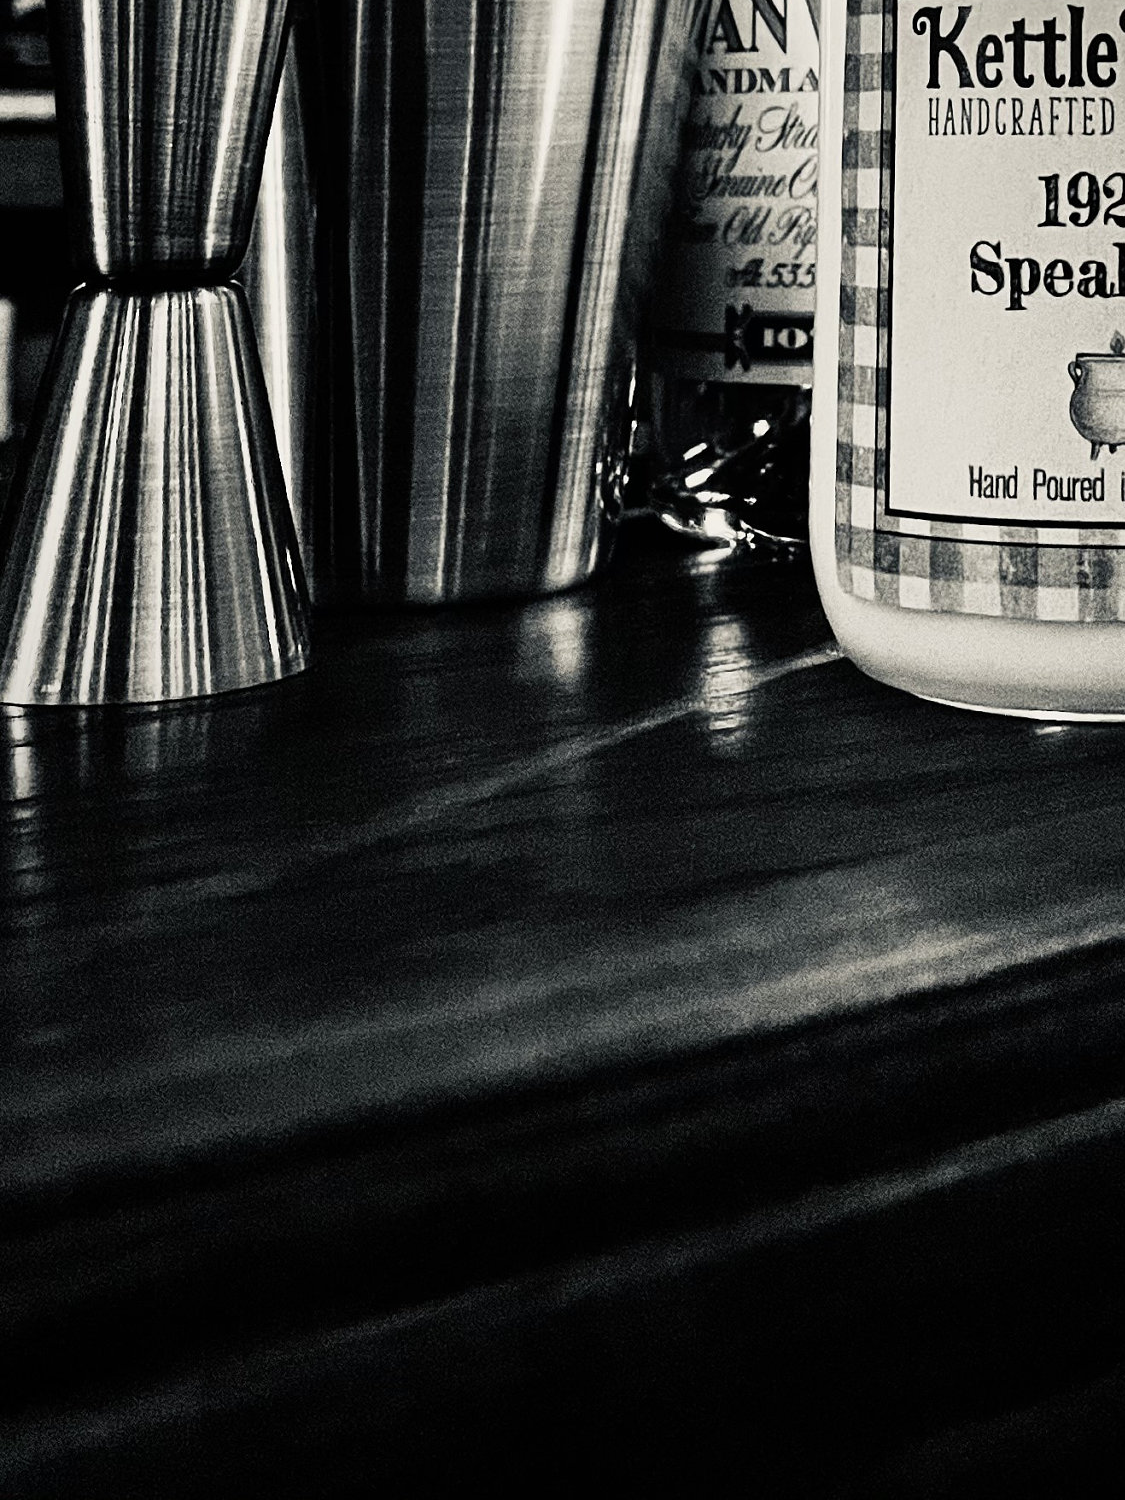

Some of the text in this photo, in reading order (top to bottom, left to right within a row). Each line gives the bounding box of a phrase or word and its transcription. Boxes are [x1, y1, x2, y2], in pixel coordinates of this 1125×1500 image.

[912, 4, 1118, 89] Kettle
[927, 97, 1116, 136] HANDCRAFTED
[968, 465, 1018, 499] Hand
[1033, 467, 1105, 501] Poured
